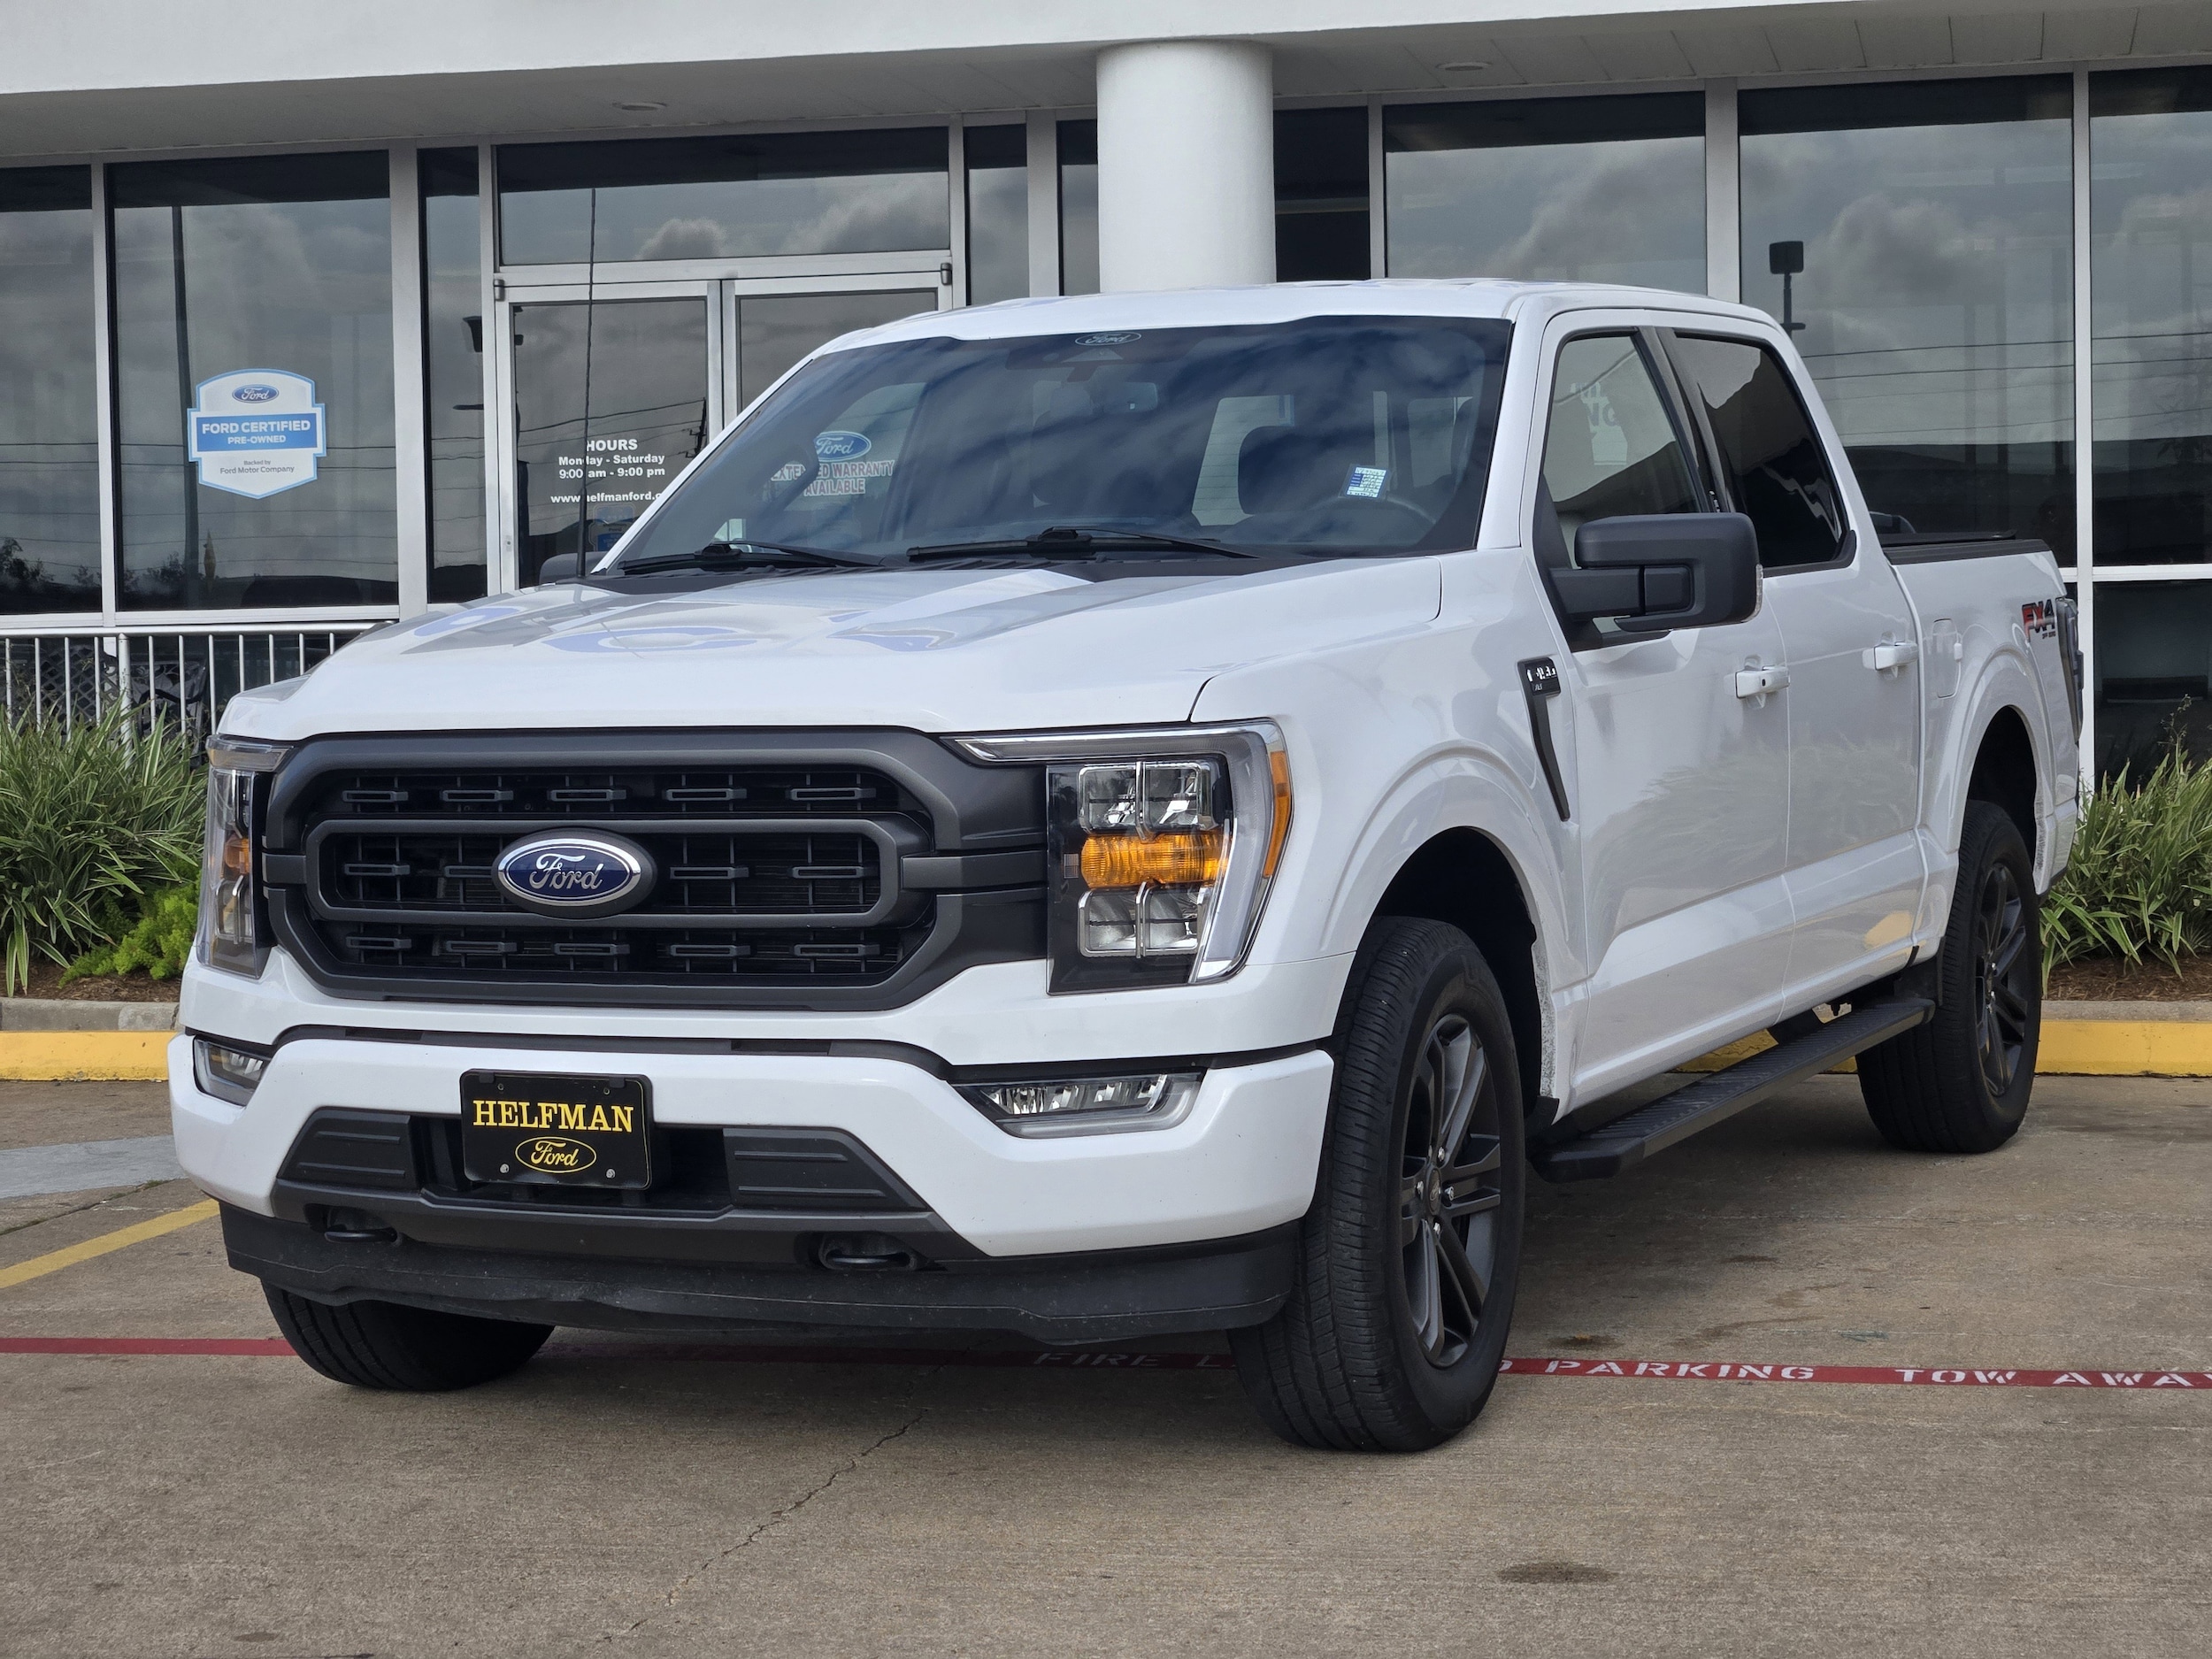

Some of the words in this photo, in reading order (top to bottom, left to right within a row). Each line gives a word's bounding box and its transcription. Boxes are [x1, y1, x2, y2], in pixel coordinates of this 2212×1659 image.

[1085, 333, 1132, 344] Ford
[241, 387, 270, 400] Ford
[202, 422, 240, 434] FORD
[241, 419, 311, 433] CERTIFIED
[227, 434, 287, 445] PRE-OWNED
[586, 439, 638, 451] HOURS
[816, 436, 853, 454] Ford
[613, 453, 665, 465] Saturday
[260, 465, 295, 475] Company
[558, 468, 583, 479] 9:00
[617, 467, 643, 477] 9:00
[646, 468, 665, 478] pm
[833, 460, 895, 478] WARRANTY
[805, 479, 865, 495] AVAILABLE
[2022, 598, 2055, 642] FX4
[529, 853, 604, 890] Ford
[472, 1100, 634, 1133] HELFMAN
[531, 1140, 580, 1166] Ford
[1033, 1352, 1170, 1367] FIRE
[1544, 1360, 1814, 1380] PARKING
[1894, 1369, 2016, 1385] TOW
[2052, 1371, 2212, 1387] AWA
